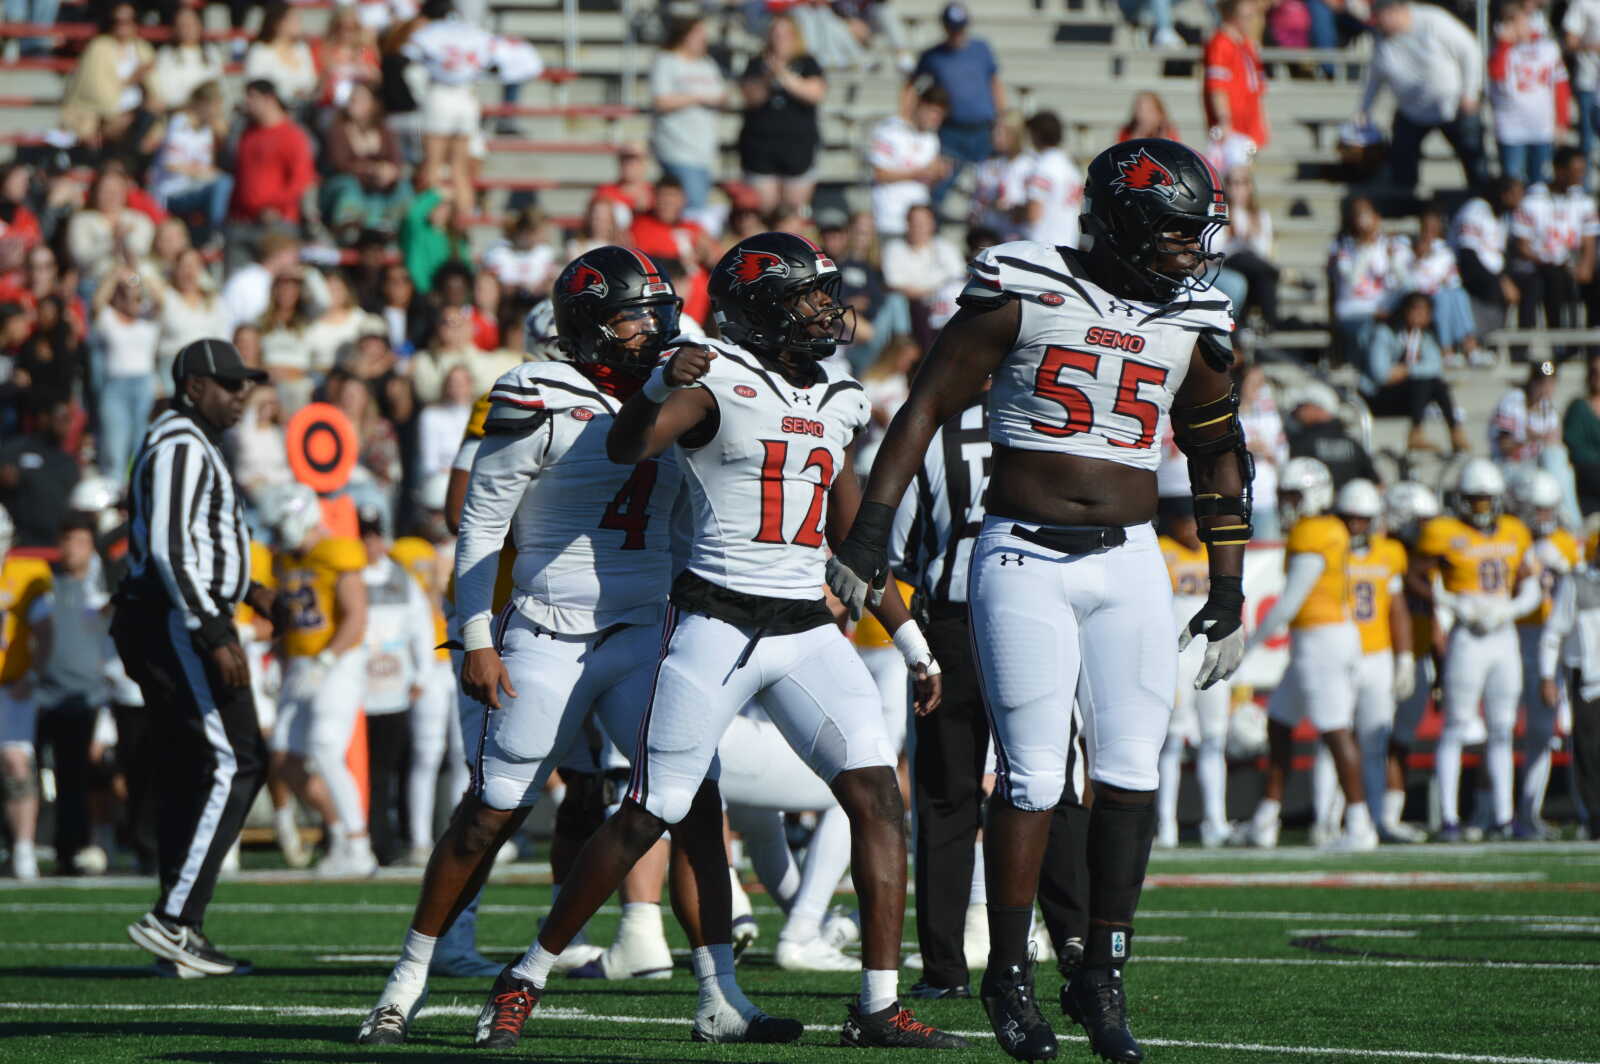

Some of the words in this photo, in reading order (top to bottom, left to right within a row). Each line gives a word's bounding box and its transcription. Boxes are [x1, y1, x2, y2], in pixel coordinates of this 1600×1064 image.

[1085, 326, 1146, 353] SEMO
[781, 416, 824, 438] SEMO
[1030, 345, 1169, 449] 55
[598, 459, 659, 549] 4
[751, 438, 834, 549] 12
